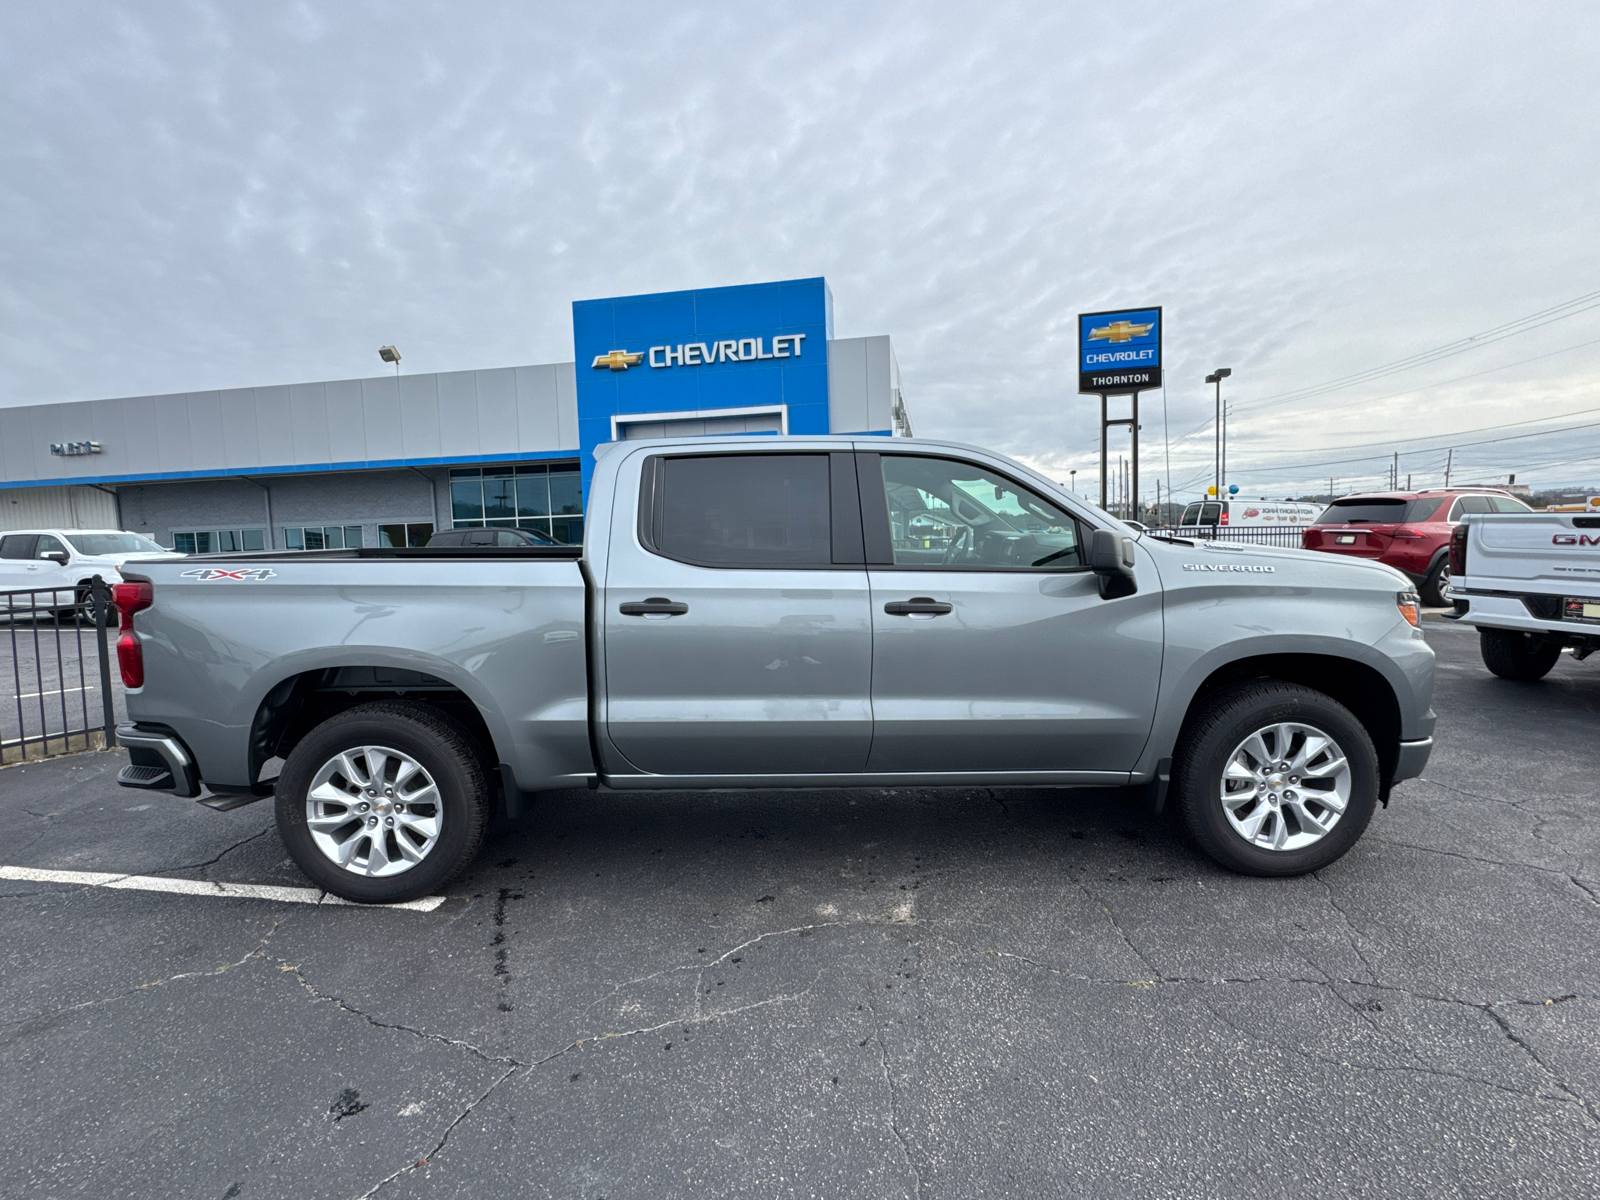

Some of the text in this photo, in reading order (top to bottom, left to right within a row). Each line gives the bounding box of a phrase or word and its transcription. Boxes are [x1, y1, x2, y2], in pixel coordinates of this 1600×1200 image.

[649, 333, 806, 369] CHEVROLET
[1086, 349, 1155, 364] CHEVROLET
[1092, 373, 1149, 386] THORNTON
[50, 441, 101, 456] PARTS
[1183, 563, 1275, 573] SILVERADO
